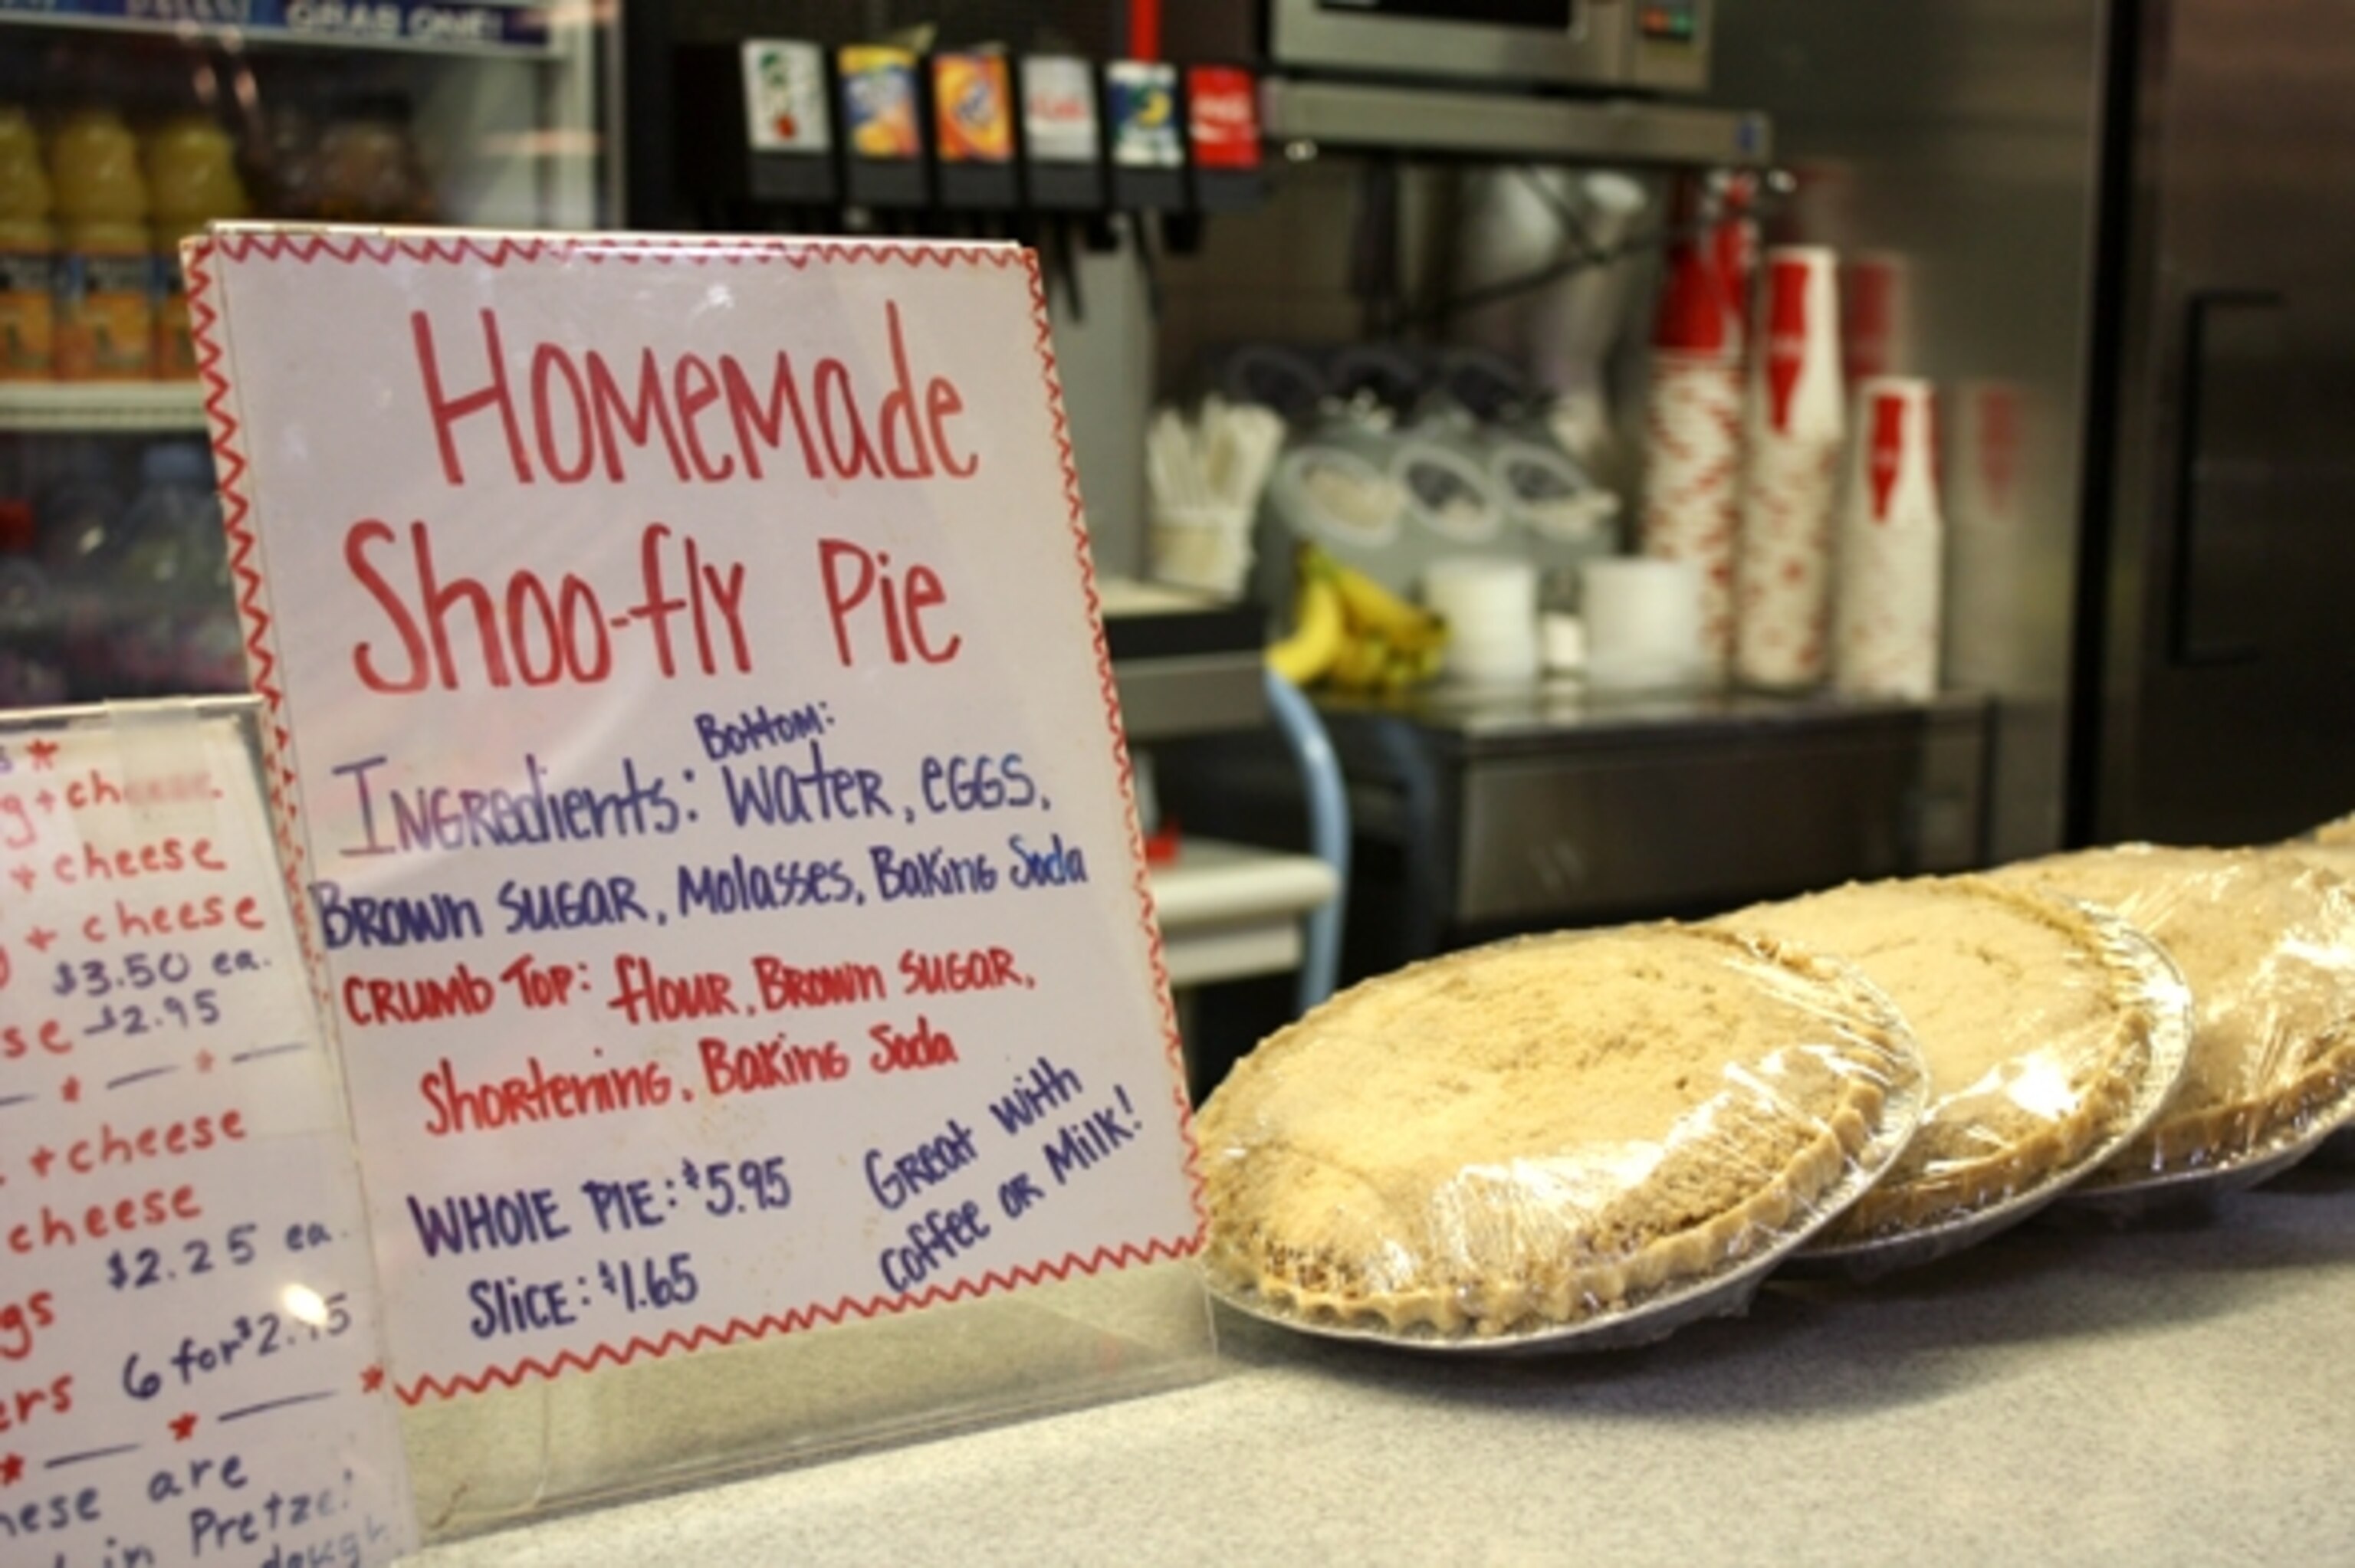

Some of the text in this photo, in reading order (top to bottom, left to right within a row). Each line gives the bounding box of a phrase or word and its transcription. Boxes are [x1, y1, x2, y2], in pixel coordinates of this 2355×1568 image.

[817, 538, 964, 668] Pie
[54, 836, 227, 884] cheese
[1008, 833, 1089, 888] Soda
[82, 896, 266, 943] cheese
[53, 951, 191, 996] $3.50
[212, 950, 271, 976] ea.
[869, 1015, 959, 1074] Soda
[67, 1109, 248, 1173] cheese
[1041, 1084, 1144, 1185] Milk!
[8, 1184, 203, 1255] cheese
[107, 1223, 258, 1291] $2.25
[123, 1353, 163, 1401] 6
[148, 1455, 248, 1504] are
